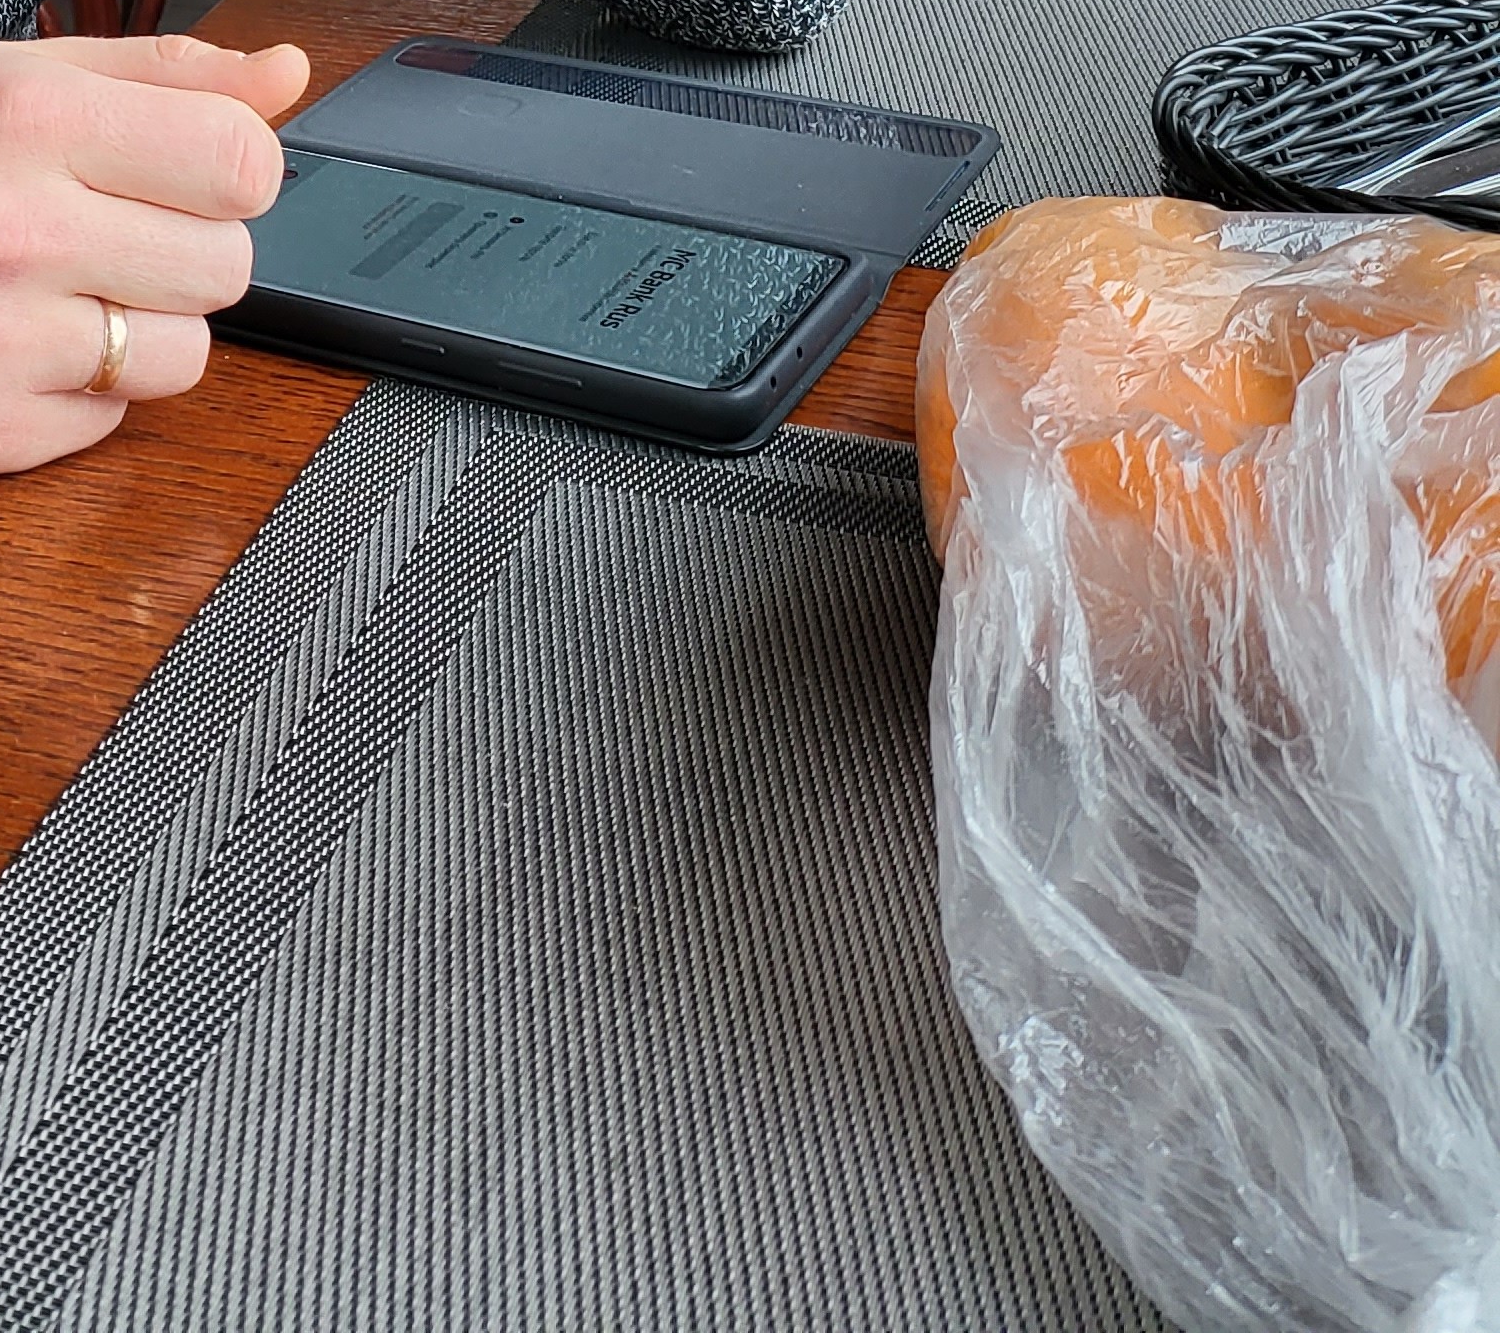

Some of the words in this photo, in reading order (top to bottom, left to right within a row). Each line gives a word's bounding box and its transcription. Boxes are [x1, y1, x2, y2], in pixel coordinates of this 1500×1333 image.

[659, 248, 697, 271] MC
[626, 269, 676, 303] Bank
[599, 303, 642, 330] Rus
